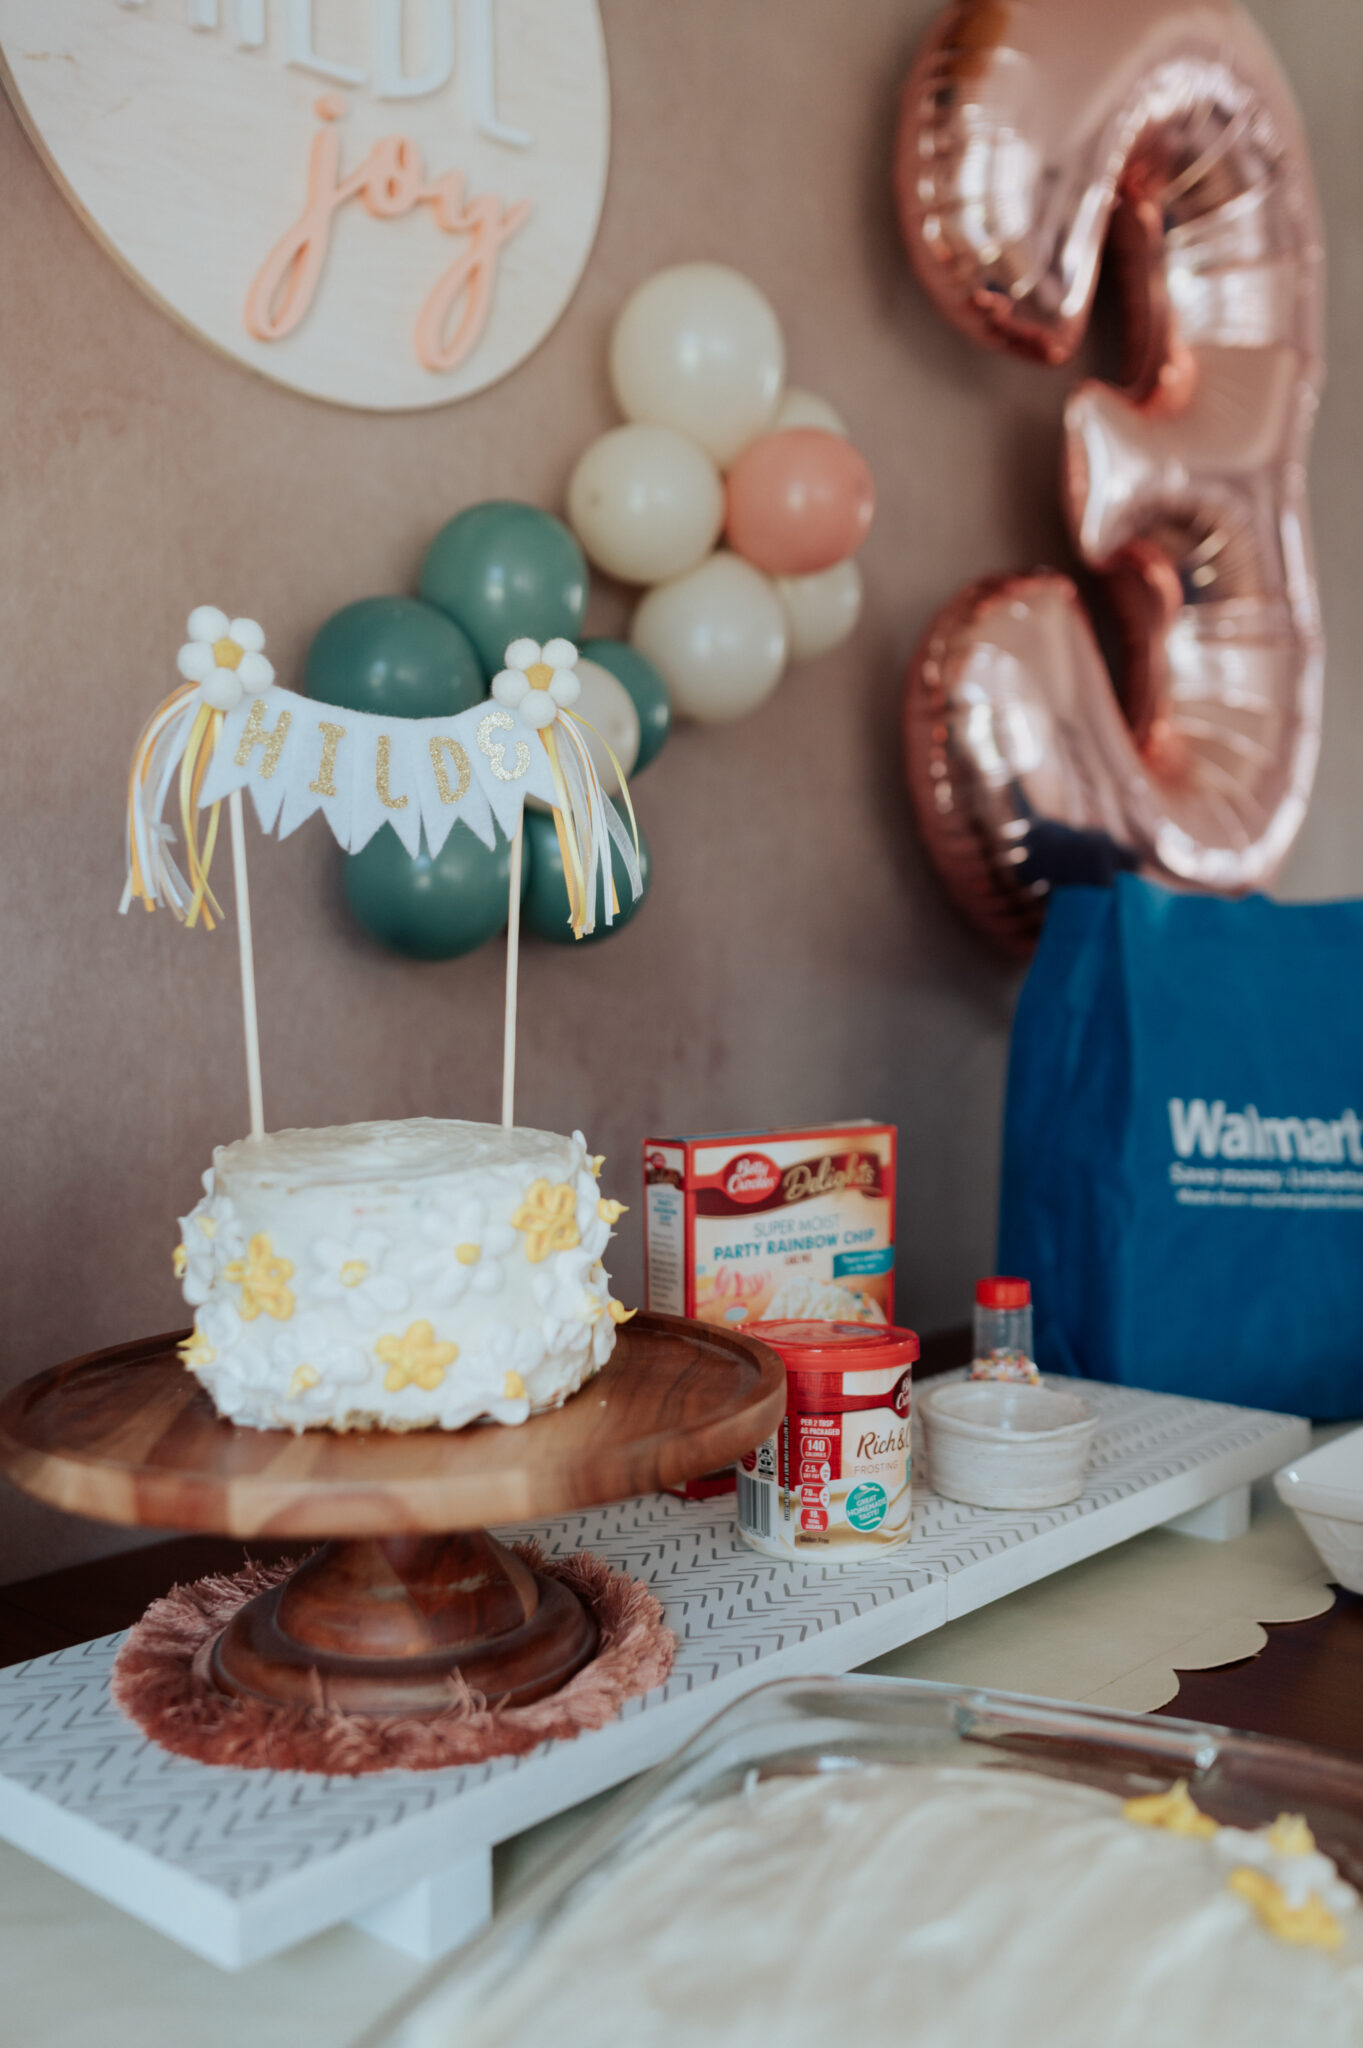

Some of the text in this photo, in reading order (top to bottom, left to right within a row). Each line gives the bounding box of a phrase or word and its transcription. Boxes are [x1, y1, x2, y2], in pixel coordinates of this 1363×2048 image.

[243, 93, 534, 375] joy
[233, 699, 532, 810] HILDE
[1169, 1097, 1363, 1165] Walmart
[754, 1213, 841, 1238] SUPER MOIST
[713, 1227, 876, 1261] PARTY RAINBOW CHIP
[807, 1439, 826, 1452] 140
[856, 1431, 896, 1460] Rich
[854, 1460, 899, 1475] FROSTING
[847, 1496, 888, 1517] HOMEMADE
